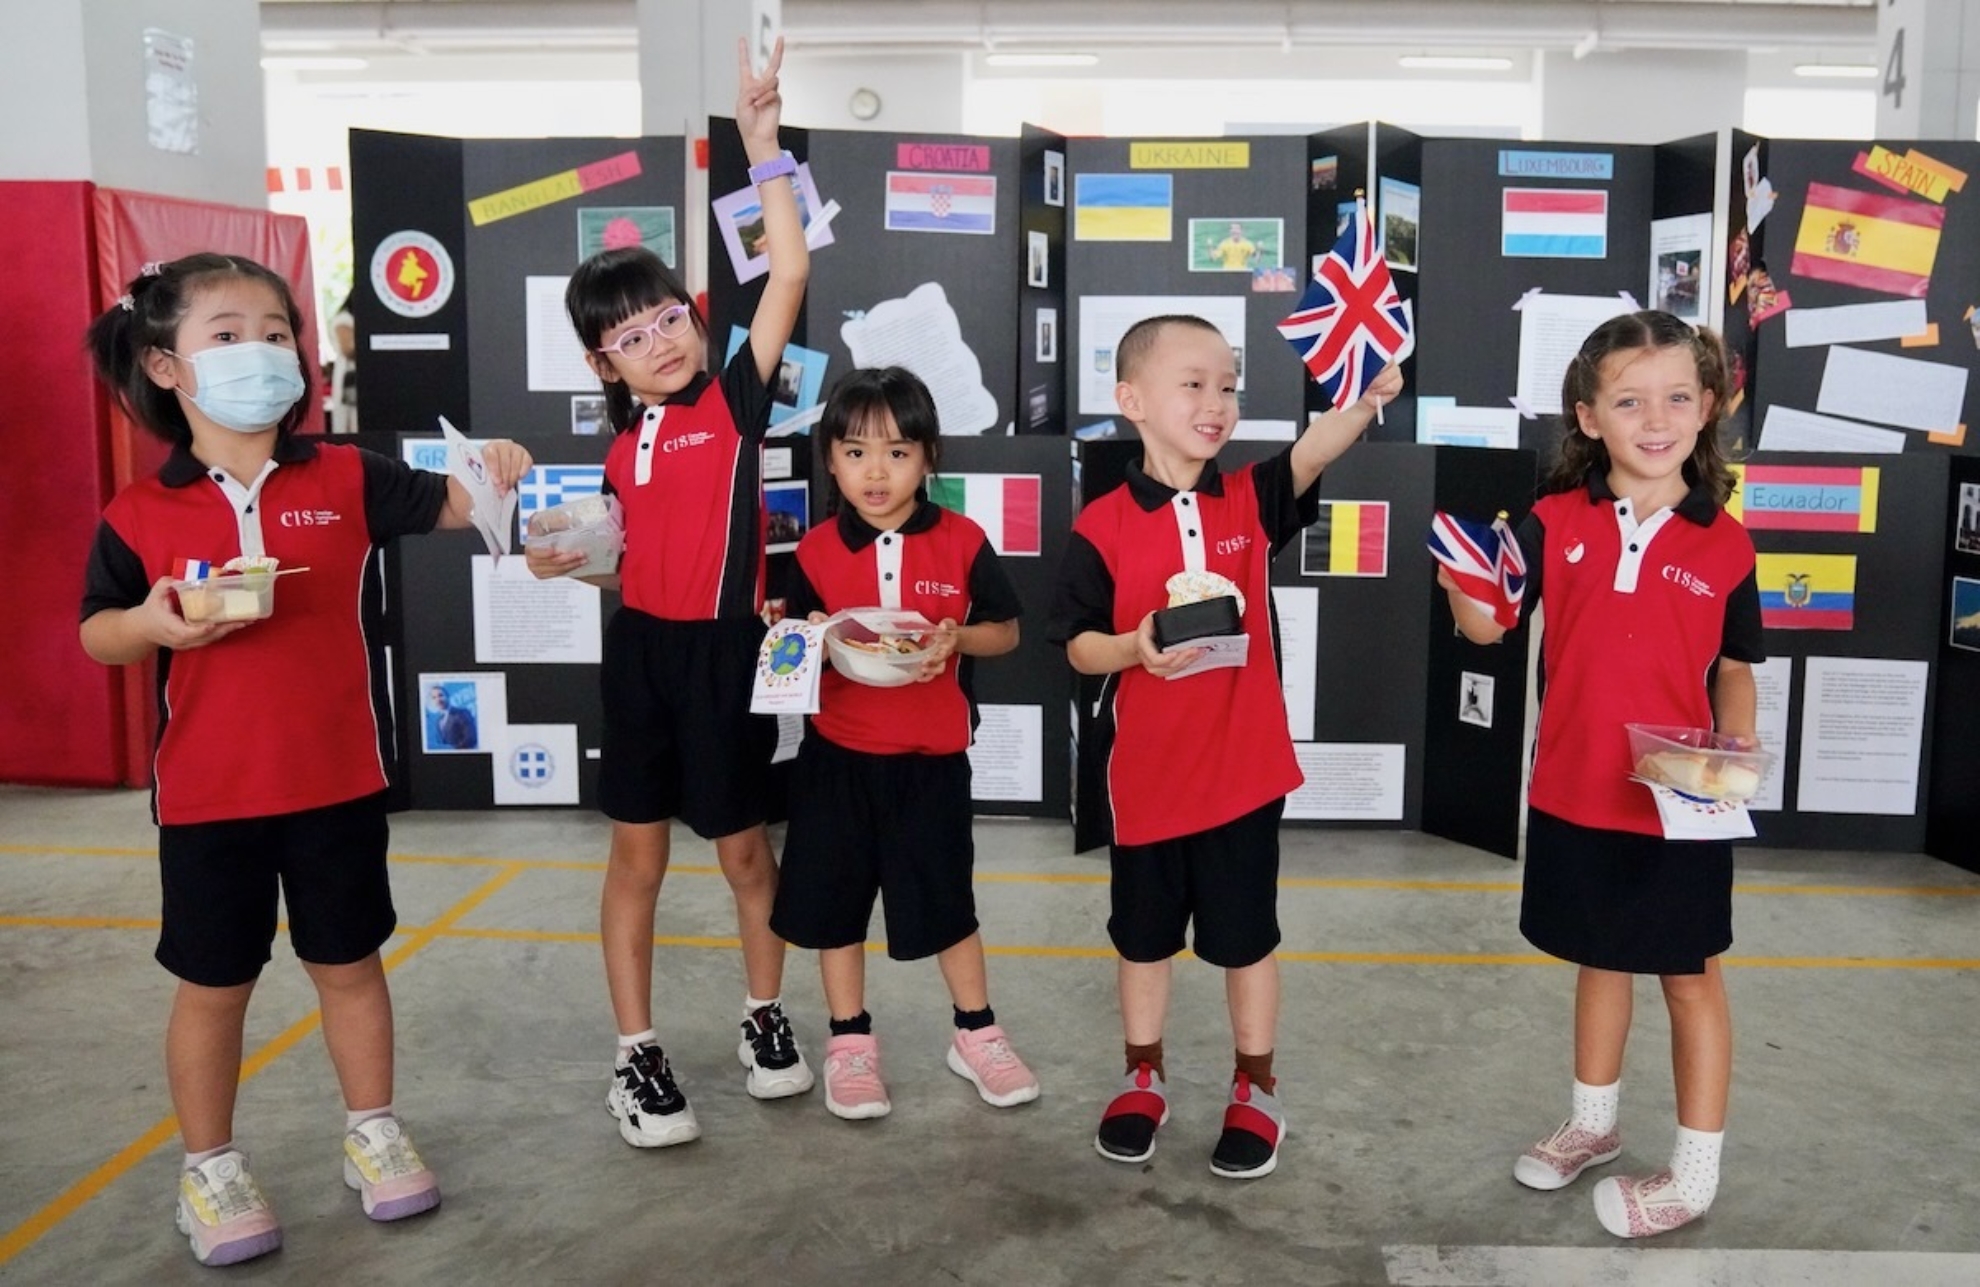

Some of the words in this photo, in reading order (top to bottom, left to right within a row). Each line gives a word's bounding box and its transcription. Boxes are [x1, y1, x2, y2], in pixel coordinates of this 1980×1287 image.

[1882, 27, 1906, 109] 4
[908, 145, 979, 169] CROATIA
[1137, 147, 1238, 165] UKRAINE
[1504, 150, 1605, 175] LUXEMBOURG
[1877, 151, 1937, 195] SPAIN
[662, 434, 689, 453] CIS
[1752, 487, 1848, 510] Ecuador
[280, 510, 314, 527] CIS
[915, 580, 940, 595] CIS
[1661, 564, 1692, 588] CIS
